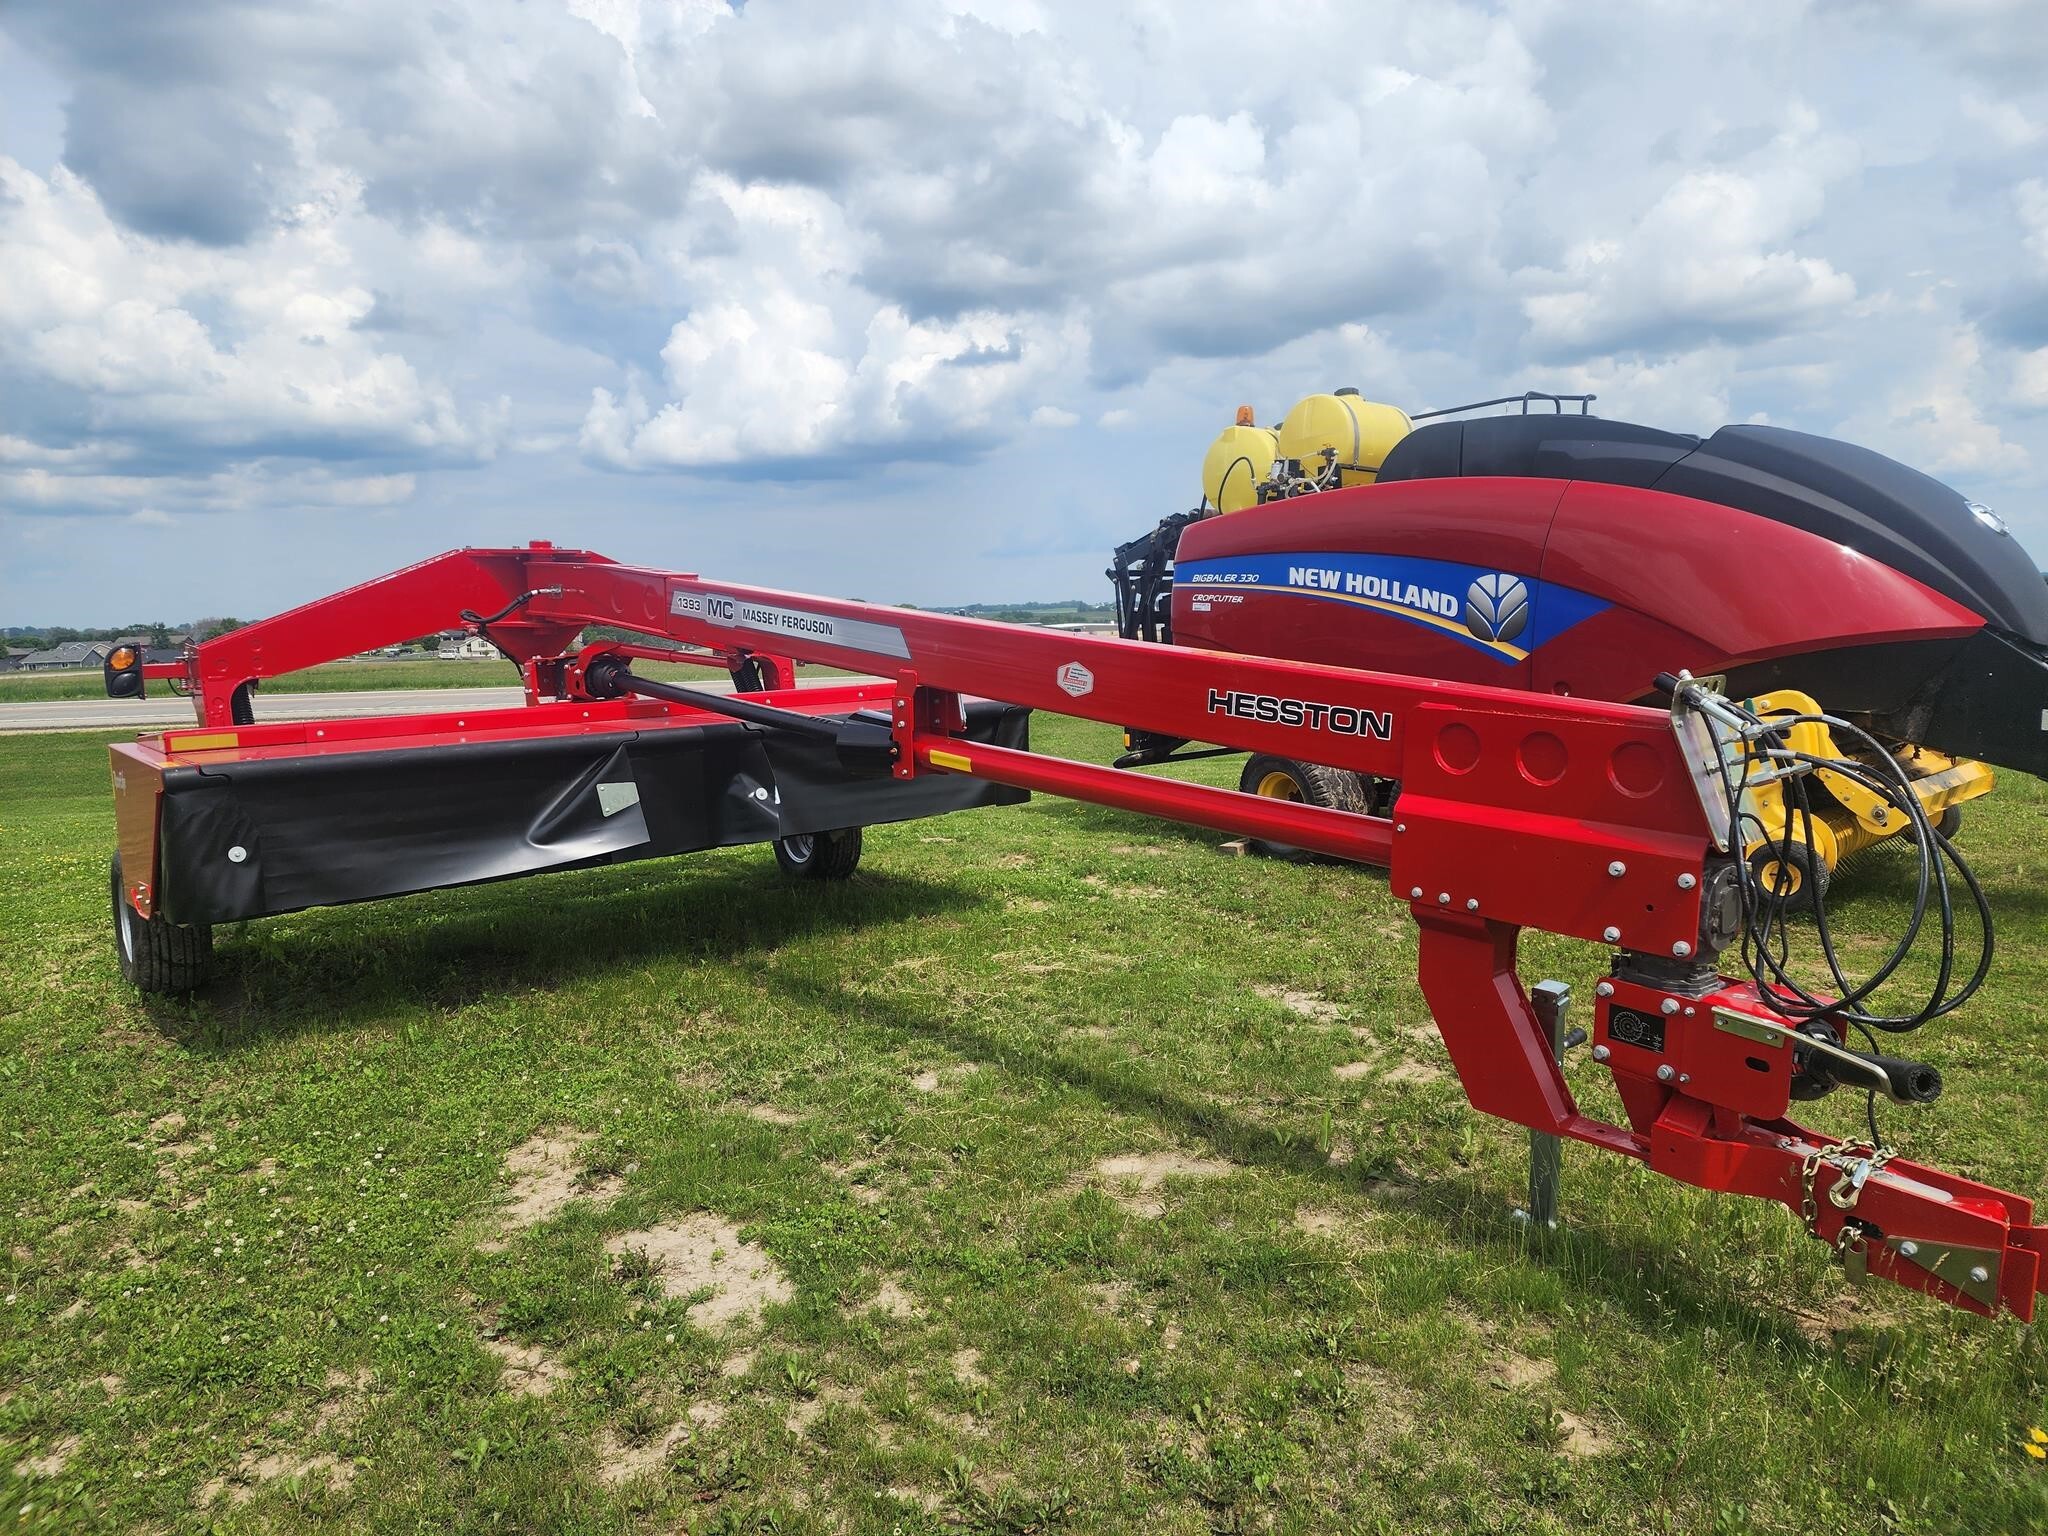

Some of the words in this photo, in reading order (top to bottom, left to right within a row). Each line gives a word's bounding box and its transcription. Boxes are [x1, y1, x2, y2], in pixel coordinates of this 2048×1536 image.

[1192, 574, 1237, 583] BIGBALER
[1238, 574, 1260, 583] 330
[1289, 567, 1341, 590] NEW
[1345, 573, 1459, 618] HOLLAND
[677, 597, 701, 611] 1393
[707, 598, 734, 620] MC
[742, 608, 779, 626] MASSEY
[781, 615, 833, 636] FERGUSON
[1192, 594, 1244, 604] CROPCUTTER
[1208, 688, 1392, 741] HESSTON
